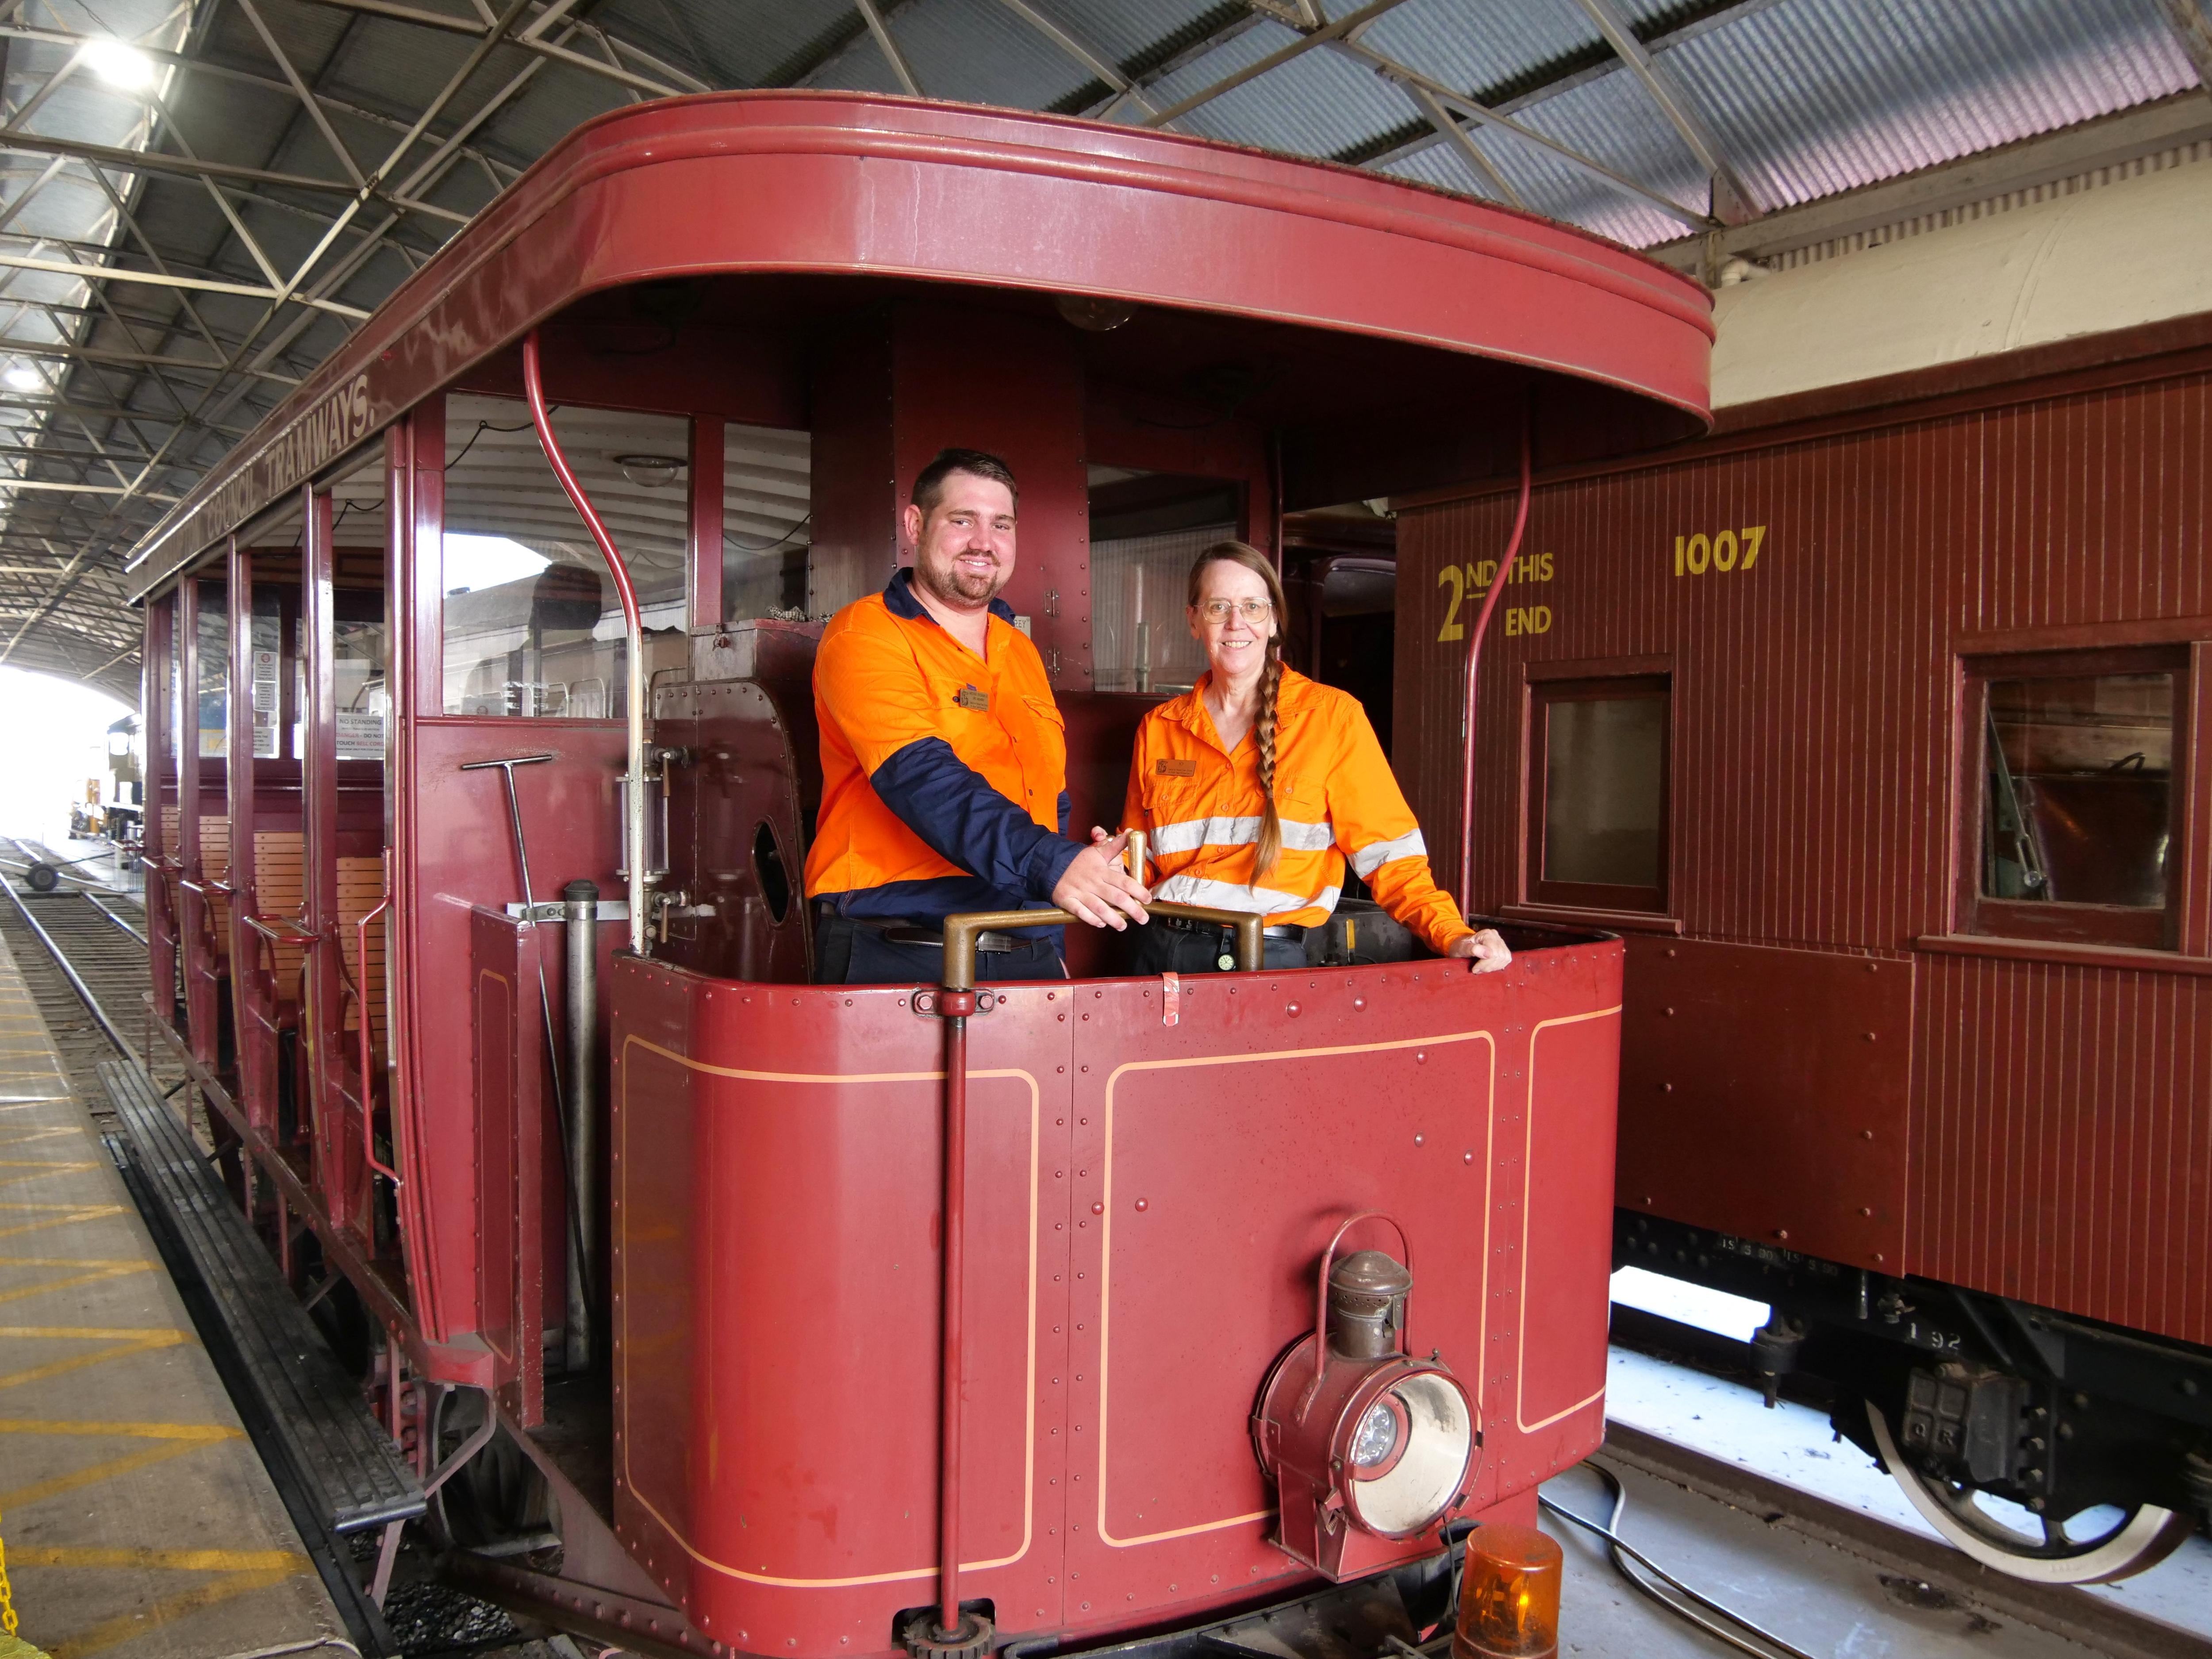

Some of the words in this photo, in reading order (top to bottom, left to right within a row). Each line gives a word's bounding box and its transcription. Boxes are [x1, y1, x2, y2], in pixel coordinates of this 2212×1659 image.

[265, 374, 374, 497] TRAMWAYS.
[1675, 526, 1766, 576] 1007
[1438, 559, 1498, 641] 2ND
[1508, 552, 1554, 584] THIS
[1506, 606, 1552, 636] END
